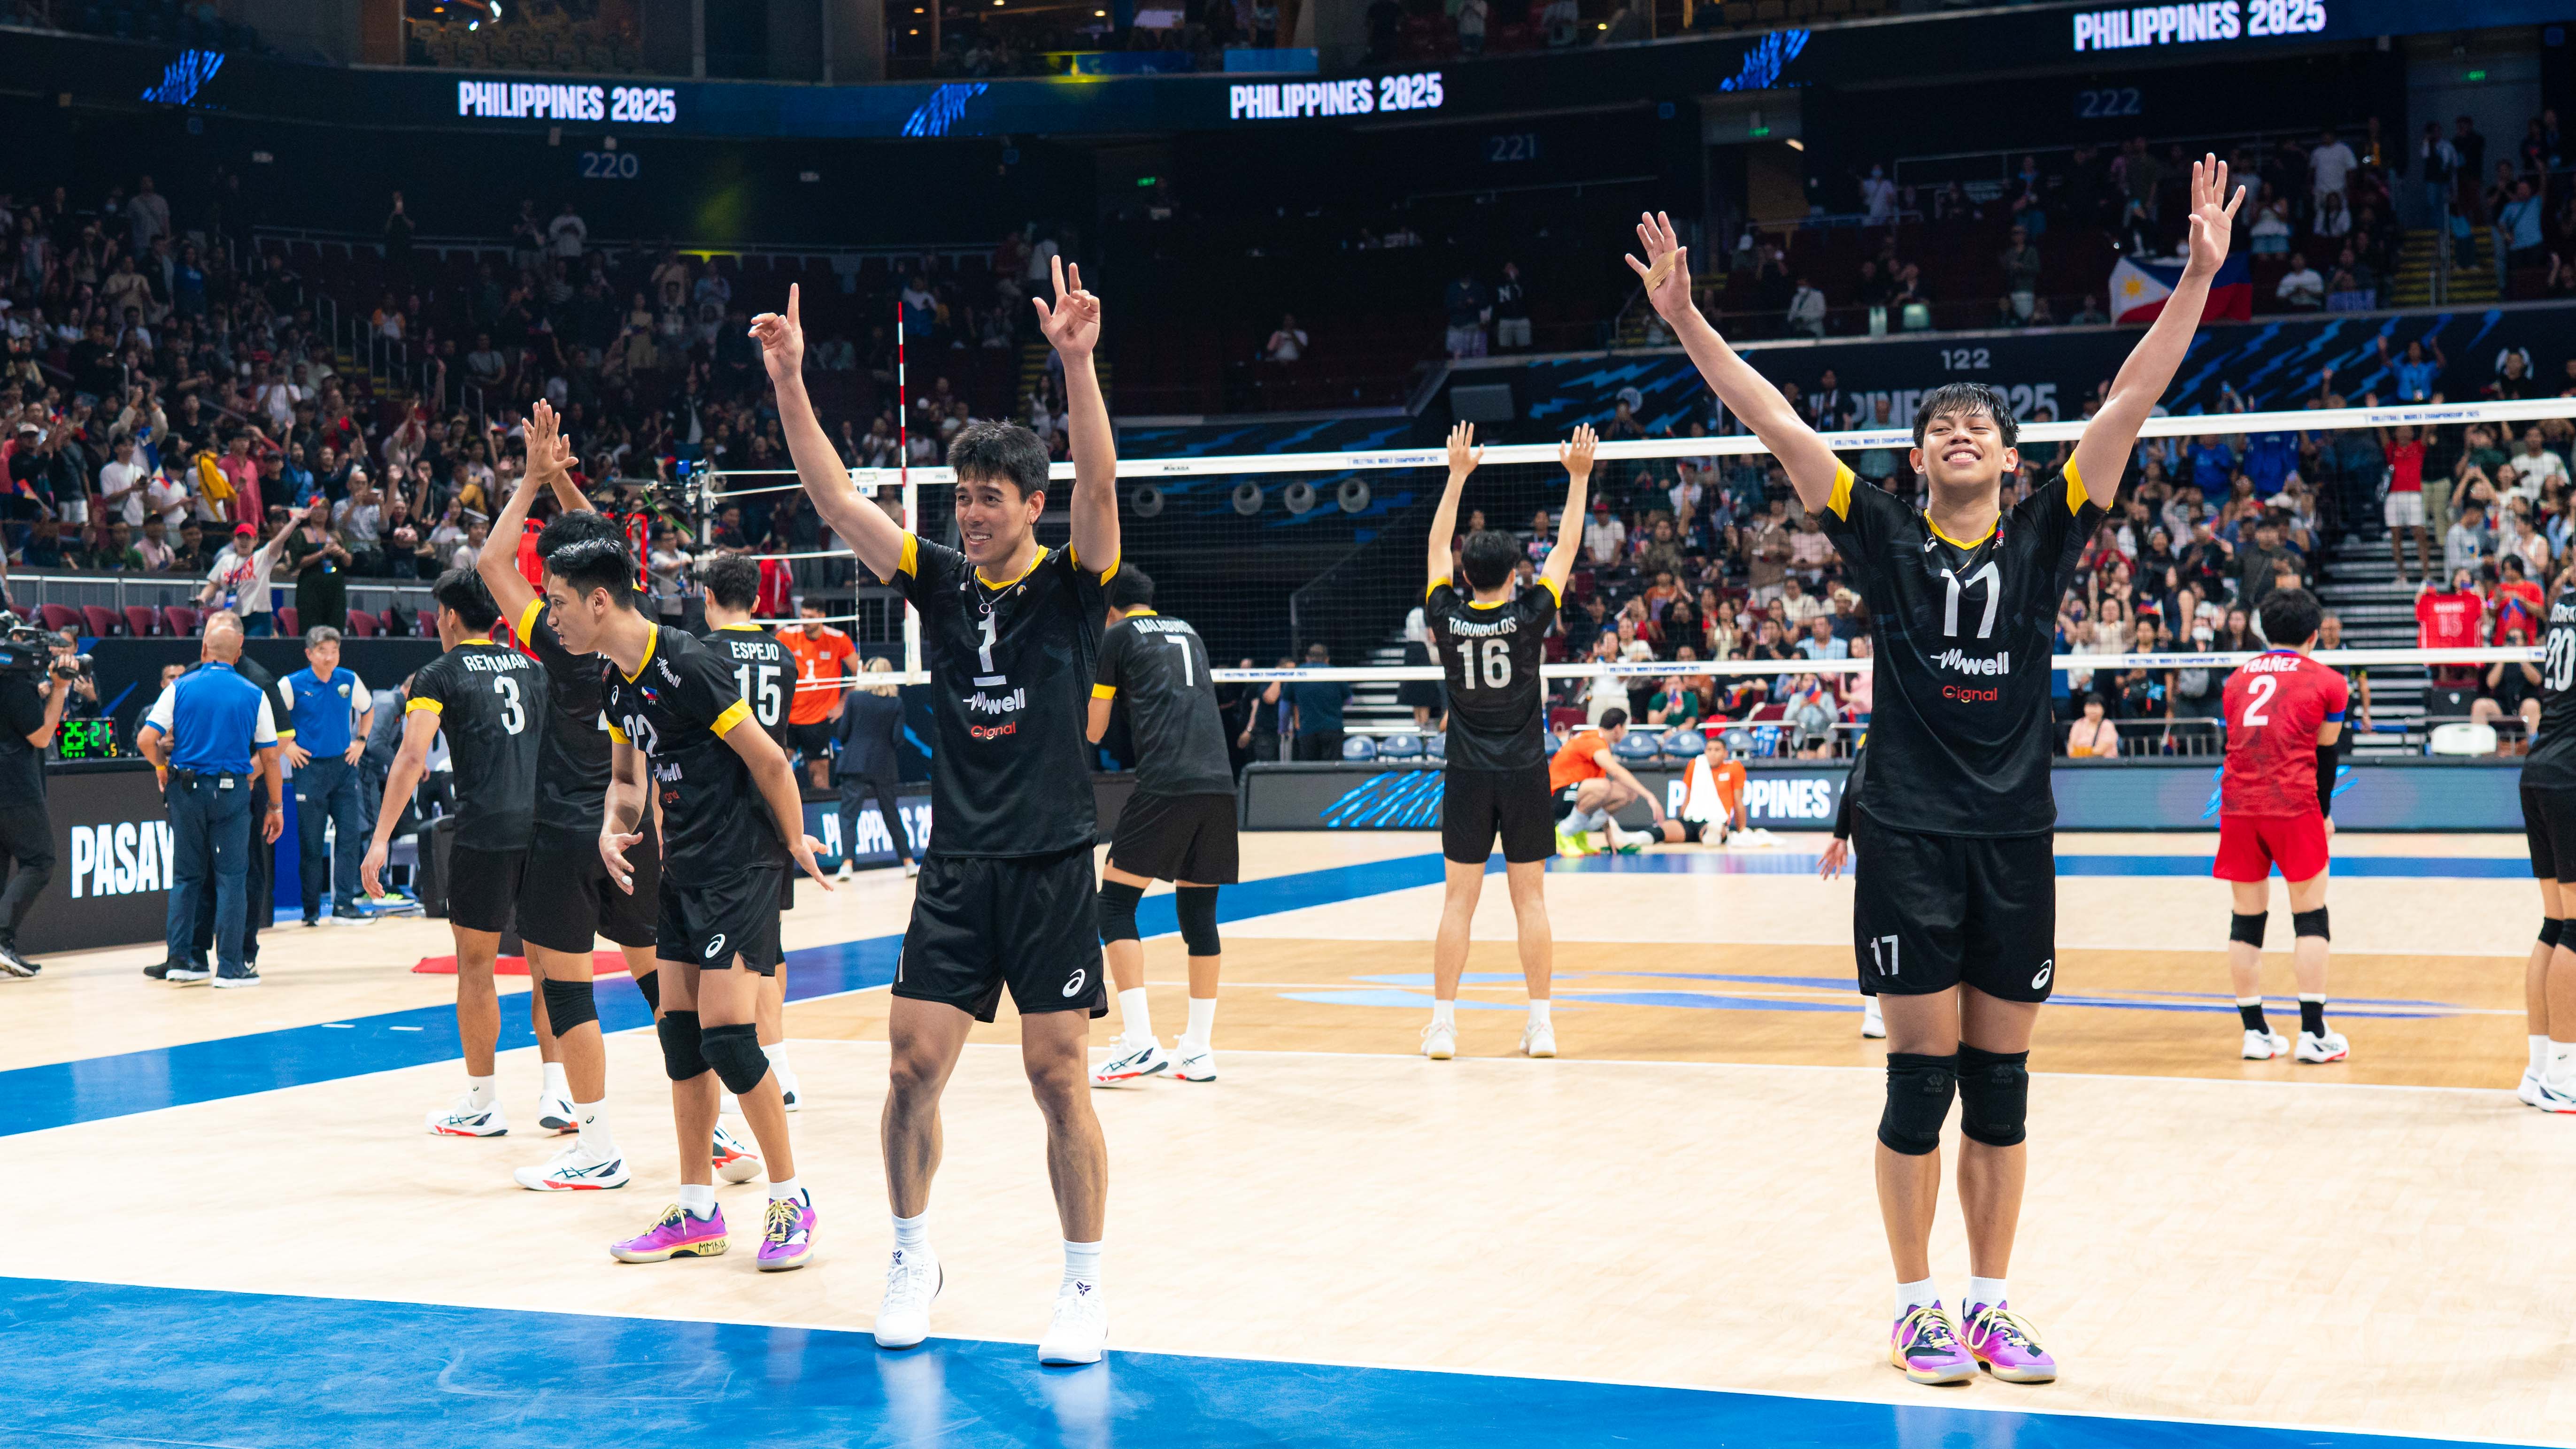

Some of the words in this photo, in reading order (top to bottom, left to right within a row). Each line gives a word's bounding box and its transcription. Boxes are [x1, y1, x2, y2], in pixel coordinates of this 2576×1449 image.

[2073, 0, 2241, 52] PHILIPPINES
[2248, 0, 2327, 36] 2025
[458, 81, 605, 121] PHILIPPINES
[610, 87, 676, 123] 2025
[1230, 78, 1374, 119] PHILIPPINES
[1380, 72, 1444, 111] 2025
[2081, 87, 2141, 117] 222
[583, 151, 639, 179] 220
[1490, 134, 1537, 162] 221
[1941, 348, 1991, 370] 122
[1940, 561, 2000, 639] 17
[978, 612, 996, 672] 1
[1449, 617, 1517, 637] TAGUIBOLOS
[730, 641, 780, 661] ESPEJO
[805, 659, 817, 685] 1
[1165, 635, 1193, 686] 7
[1457, 639, 1512, 690] 16
[2545, 628, 2576, 692] 20
[494, 675, 525, 735] 3
[733, 663, 781, 726] 15
[1942, 685, 1998, 703] Cignal
[2243, 674, 2277, 727] 2
[623, 714, 658, 757] 22
[970, 721, 1017, 740] Cignal
[71, 819, 174, 898] PASAY
[1870, 934, 1899, 976] 17
